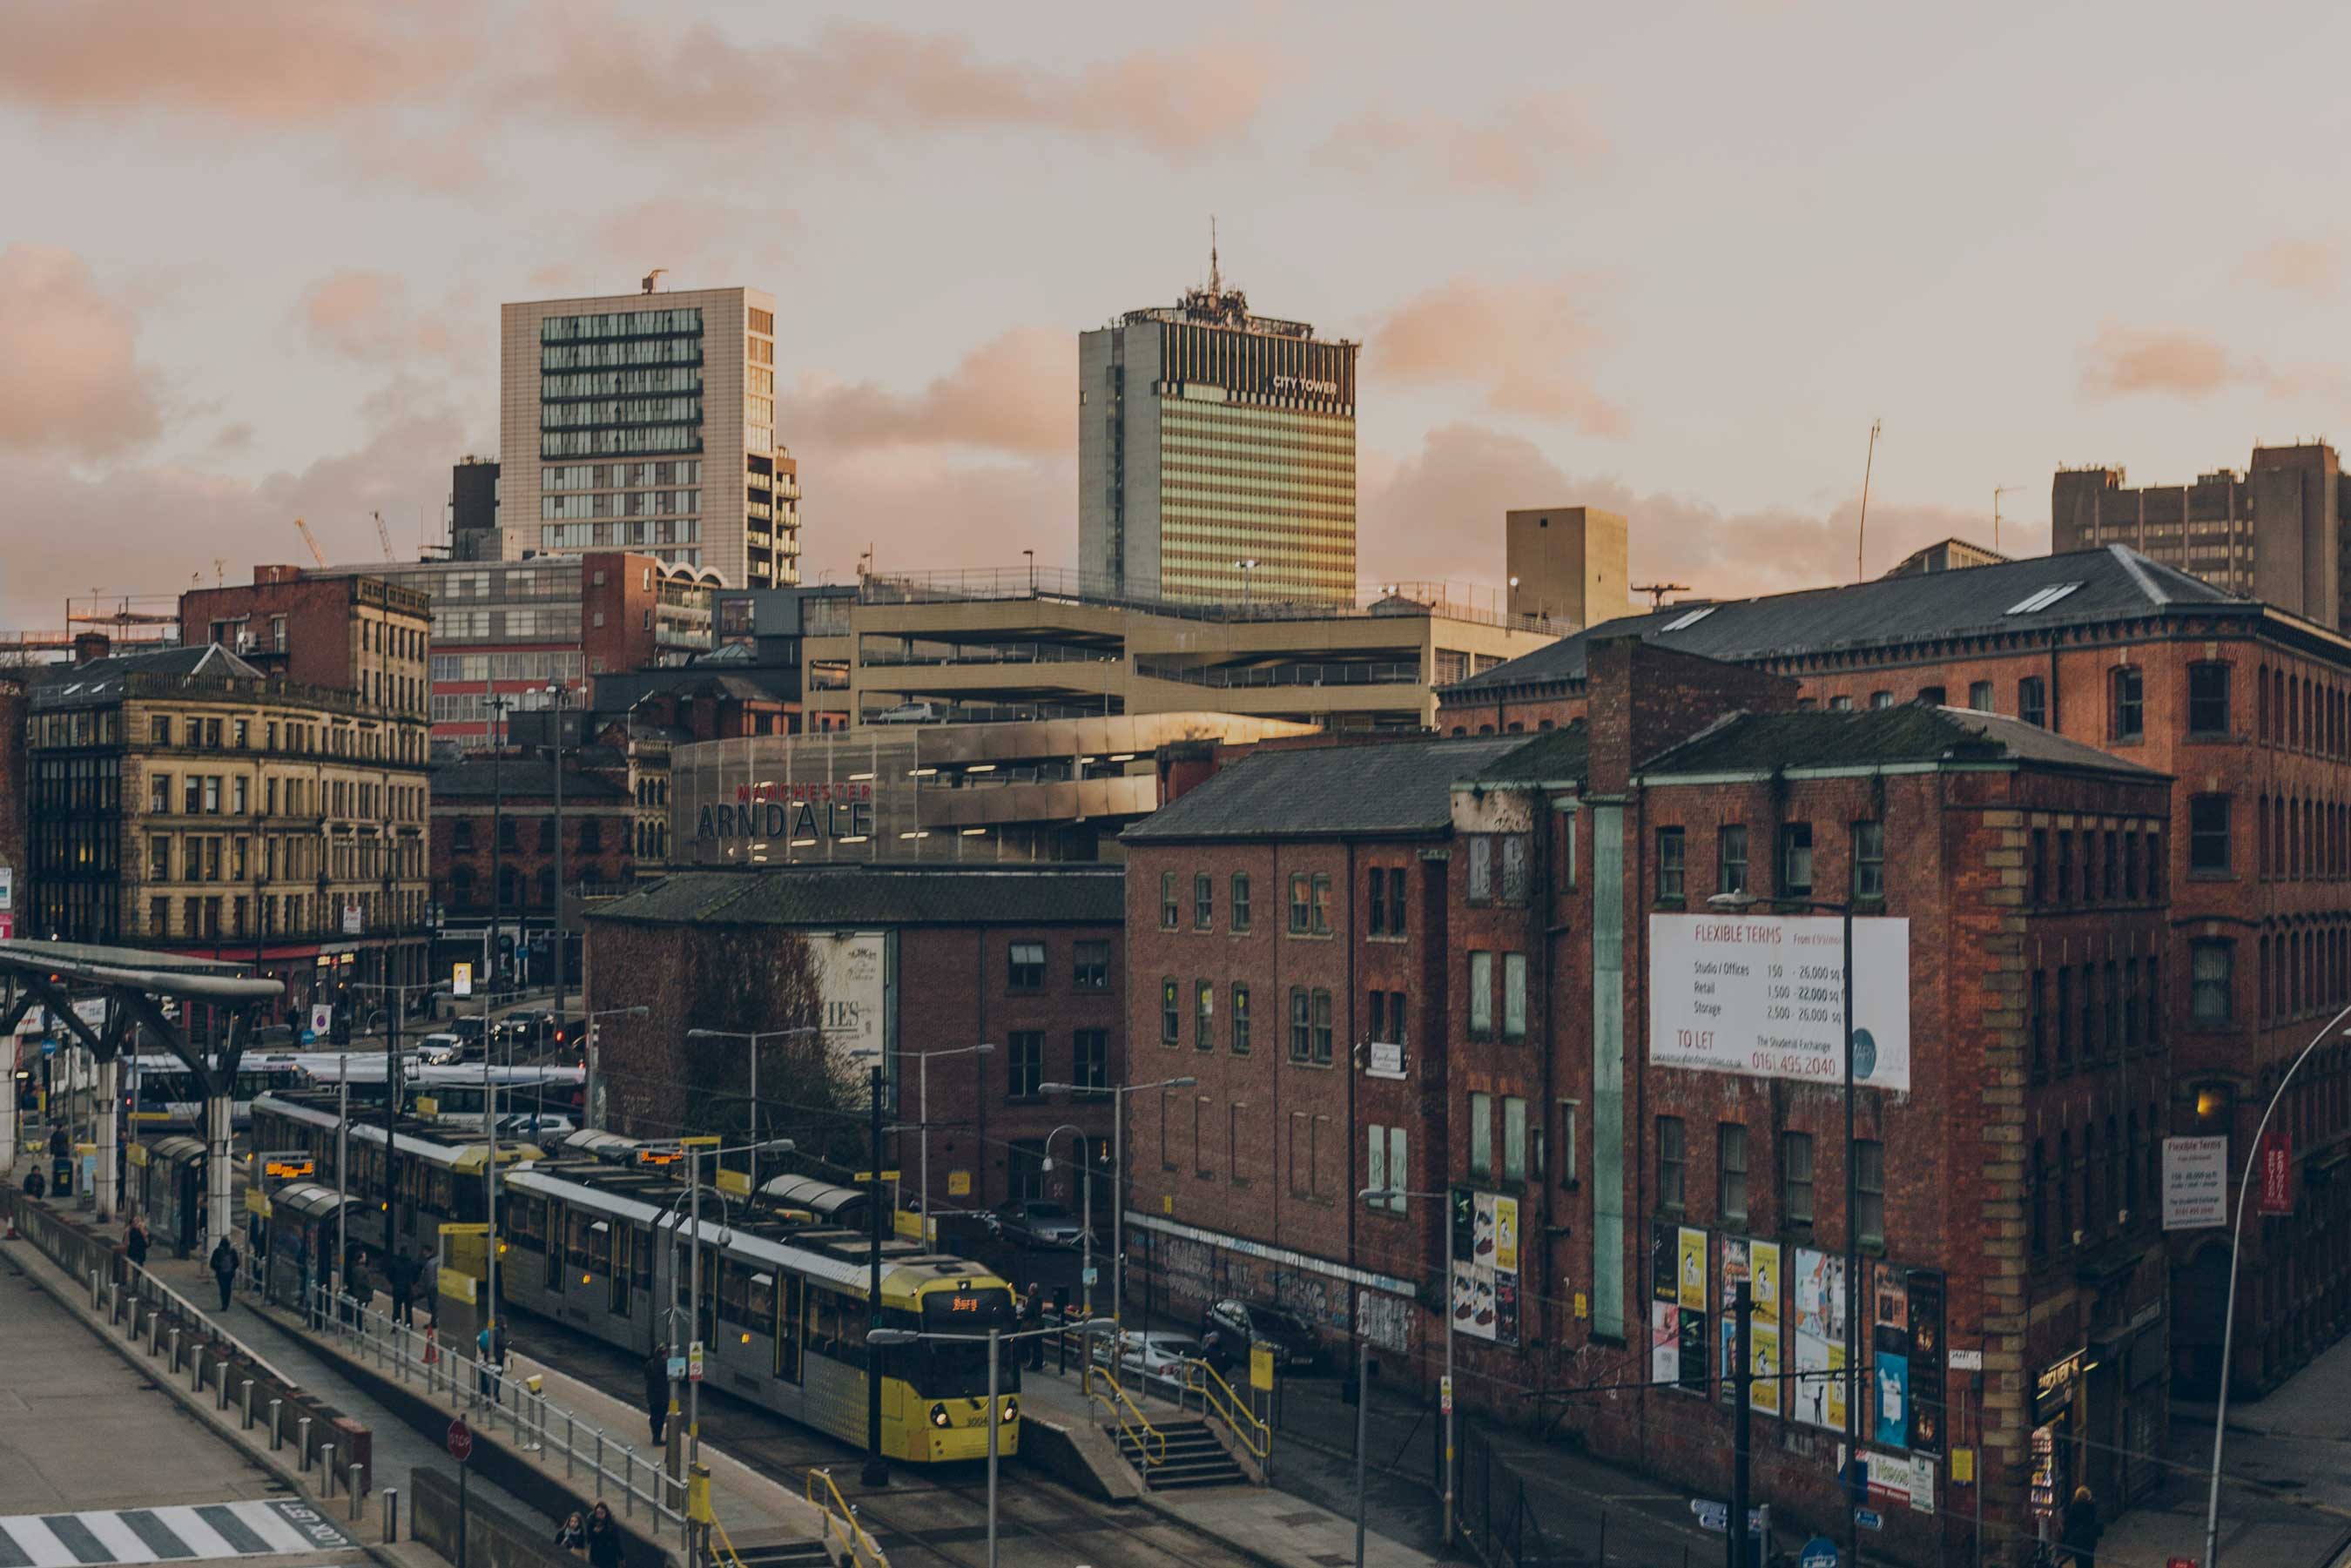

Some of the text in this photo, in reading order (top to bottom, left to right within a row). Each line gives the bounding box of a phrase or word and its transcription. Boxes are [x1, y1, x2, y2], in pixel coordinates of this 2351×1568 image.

[1273, 375, 1337, 395] CITY TOWER
[738, 783, 871, 802] MANCHESTER
[697, 802, 874, 841] ARNDALE
[1695, 925, 1742, 943] FLEXIBLE
[1747, 925, 1782, 946] TERMS
[1694, 961, 1718, 975] Studio
[1724, 962, 1750, 977] Offices
[1768, 965, 1783, 978] 150
[1800, 966, 1829, 980] 26,000
[1694, 981, 1715, 994] Retail
[1798, 986, 1828, 1002] 22,000
[829, 1001, 859, 1027] IES
[1694, 1000, 1721, 1017] Storage
[1677, 1030, 1714, 1050] TO LET
[1780, 1055, 1802, 1073] 495
[1805, 1057, 1836, 1077] 2040
[953, 1296, 978, 1312] Bury
[449, 1434, 471, 1449] STOP
